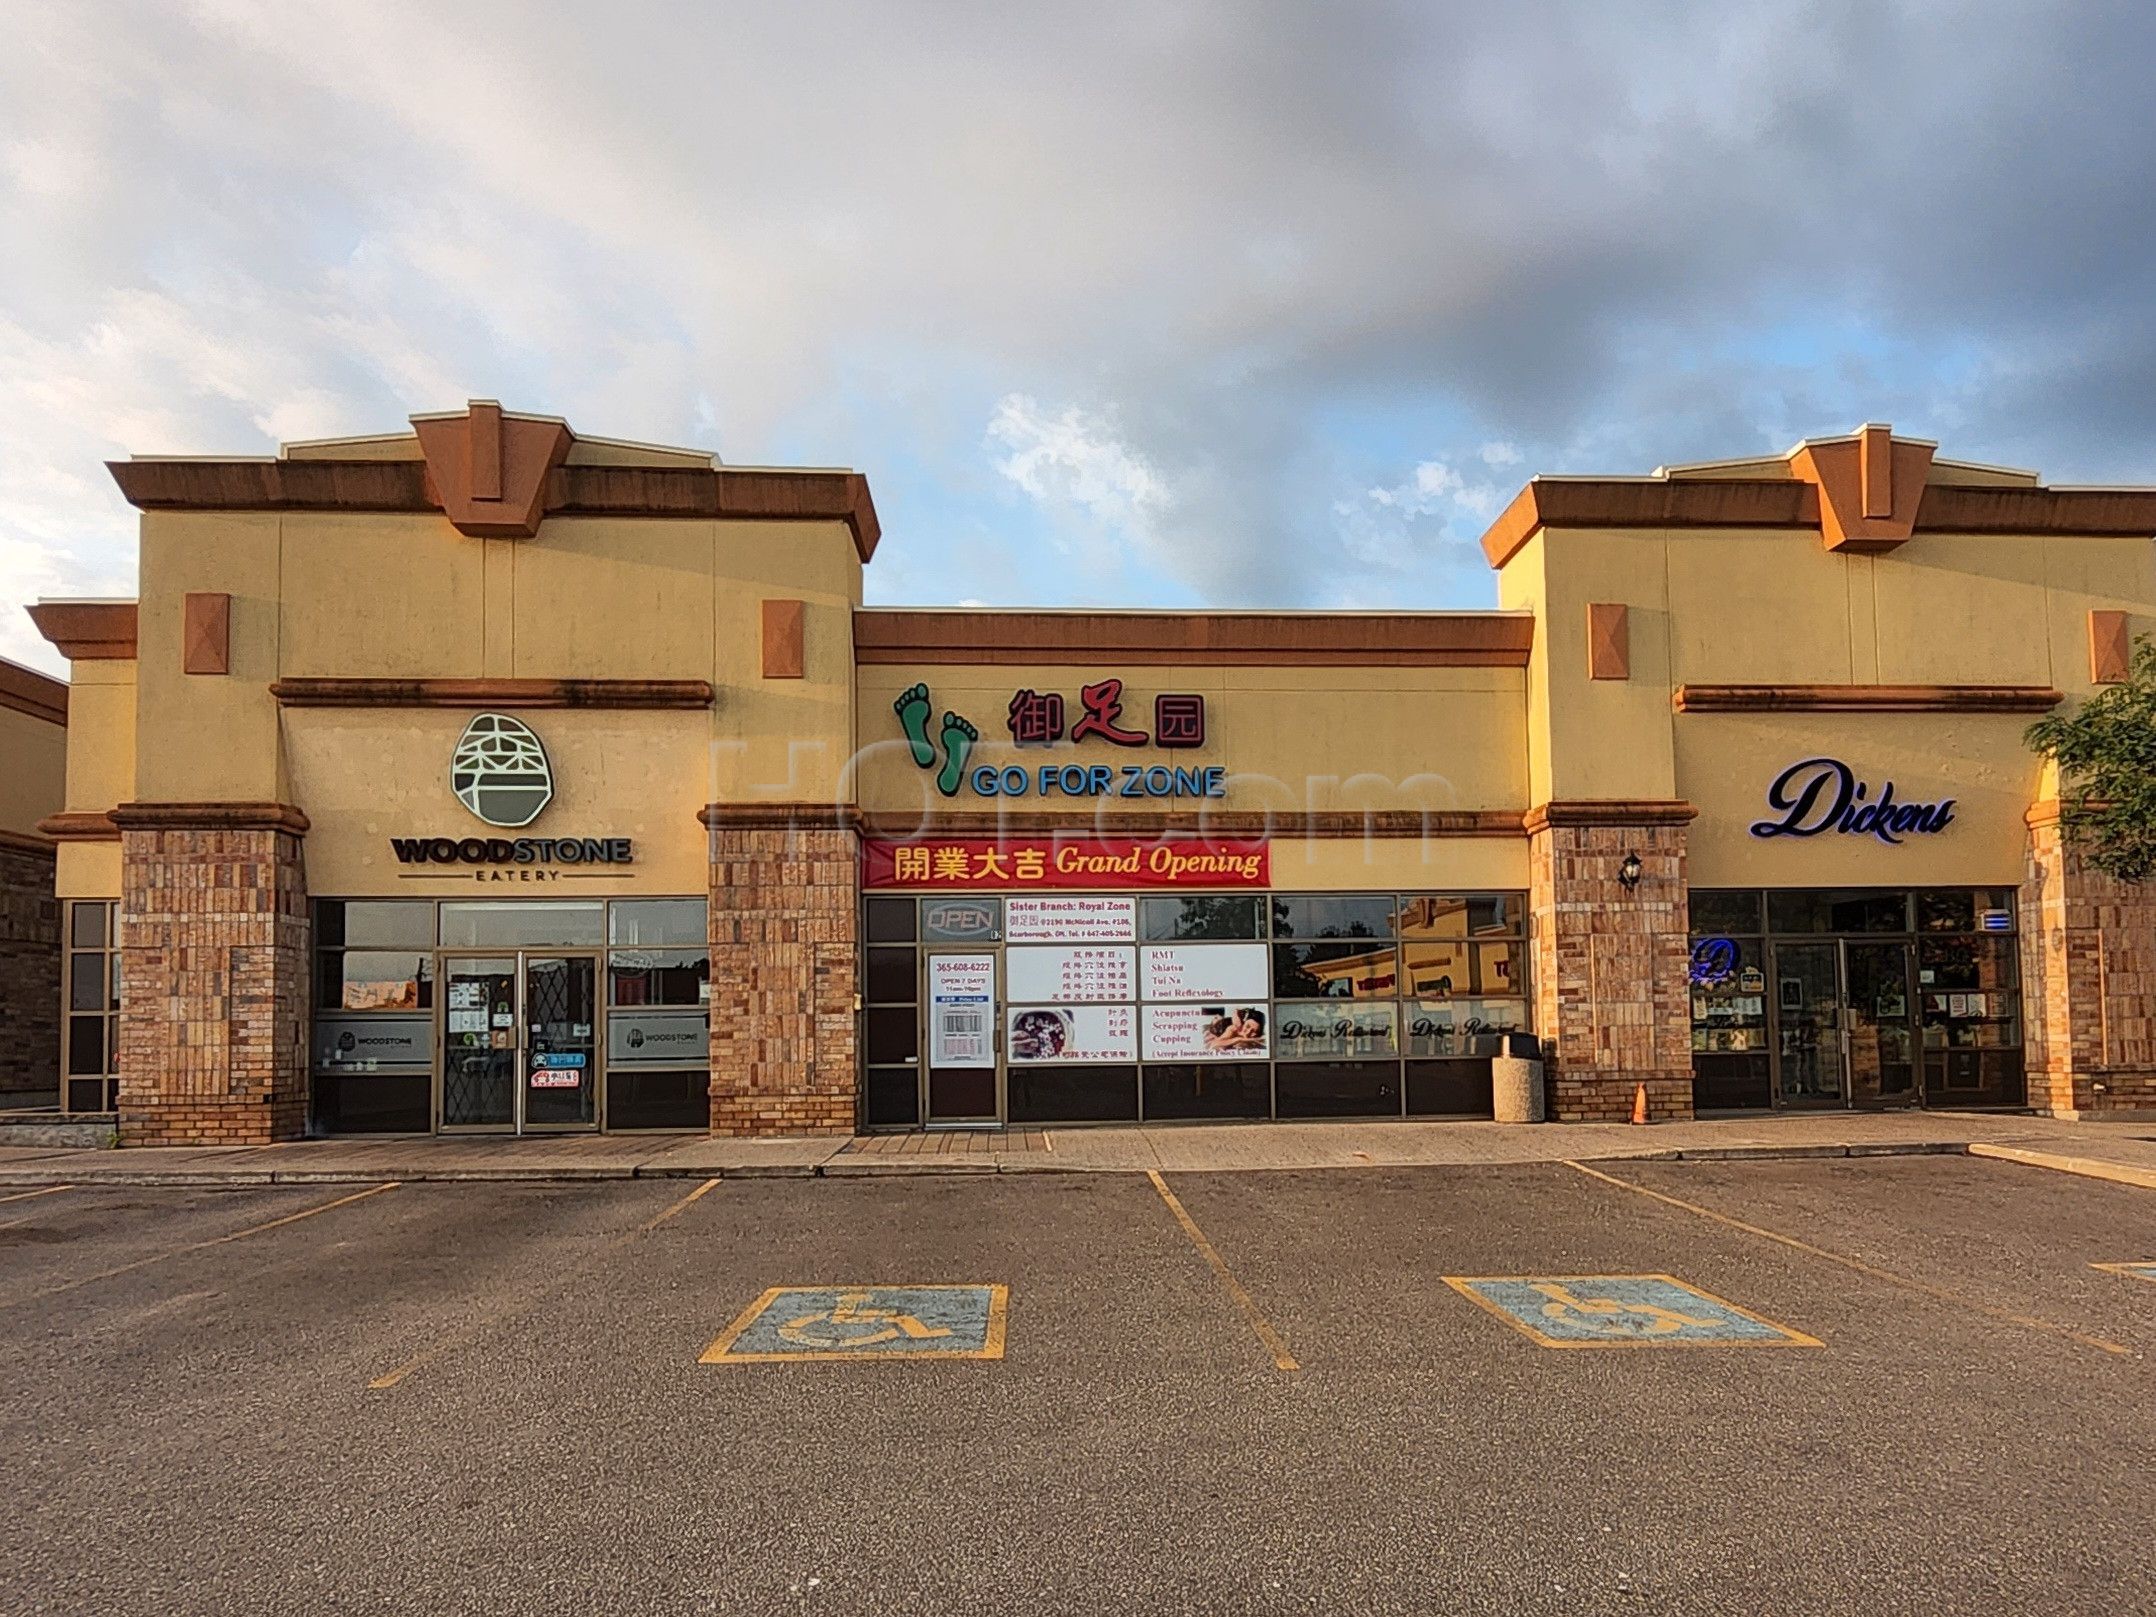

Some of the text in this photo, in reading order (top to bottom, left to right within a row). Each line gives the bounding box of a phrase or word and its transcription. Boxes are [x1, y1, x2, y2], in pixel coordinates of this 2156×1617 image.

[1007, 679, 1205, 748] 御足园
[971, 765, 1226, 797] GO FOR ZONE
[1750, 758, 1957, 844] Dickens
[390, 838, 633, 863] WOODSTONE
[1056, 846, 1262, 880] Grand Opening
[476, 870, 560, 881] EATERY
[894, 847, 1046, 881] 開業大吉
[1009, 901, 1131, 912] Sister Branch: Royal Zone
[926, 910, 994, 929] OPEN
[1152, 951, 1174, 959] RMT
[1153, 988, 1223, 998] Foot Reflexology
